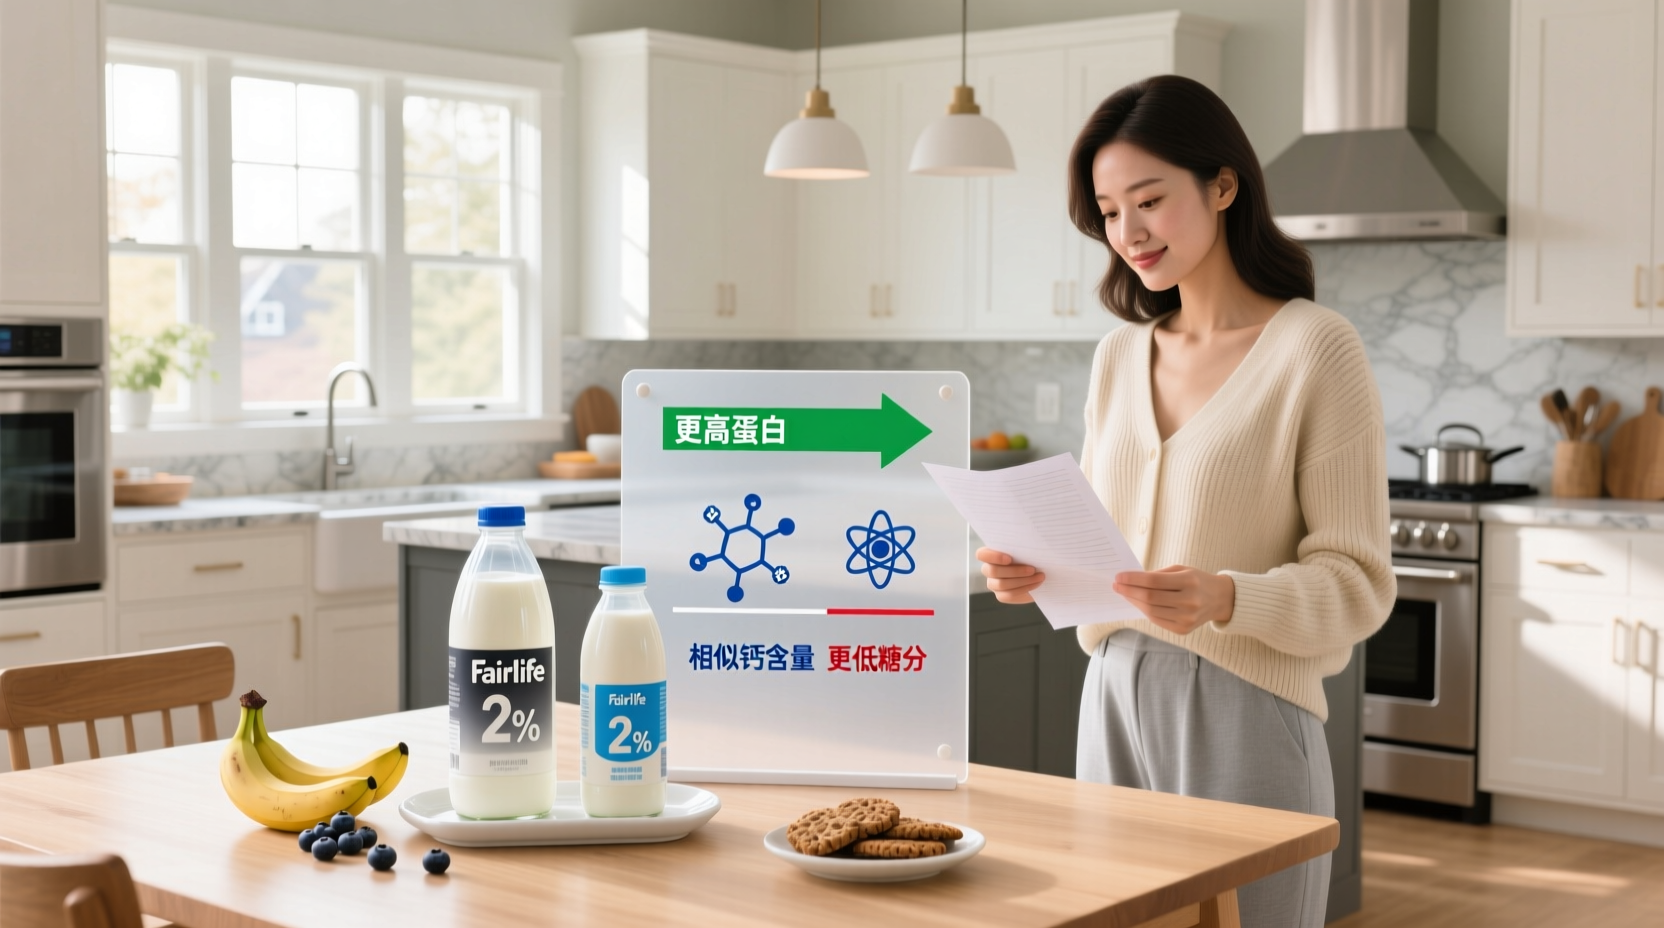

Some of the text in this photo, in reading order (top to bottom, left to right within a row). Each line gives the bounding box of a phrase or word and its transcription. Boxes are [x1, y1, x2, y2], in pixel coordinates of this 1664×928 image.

[675, 413, 785, 446] 更高蛋白
[471, 657, 545, 684] Fairlife
[688, 642, 927, 673] 相似钙含量 更低糖分
[481, 693, 540, 743] 2%
[608, 715, 652, 754] 2%
